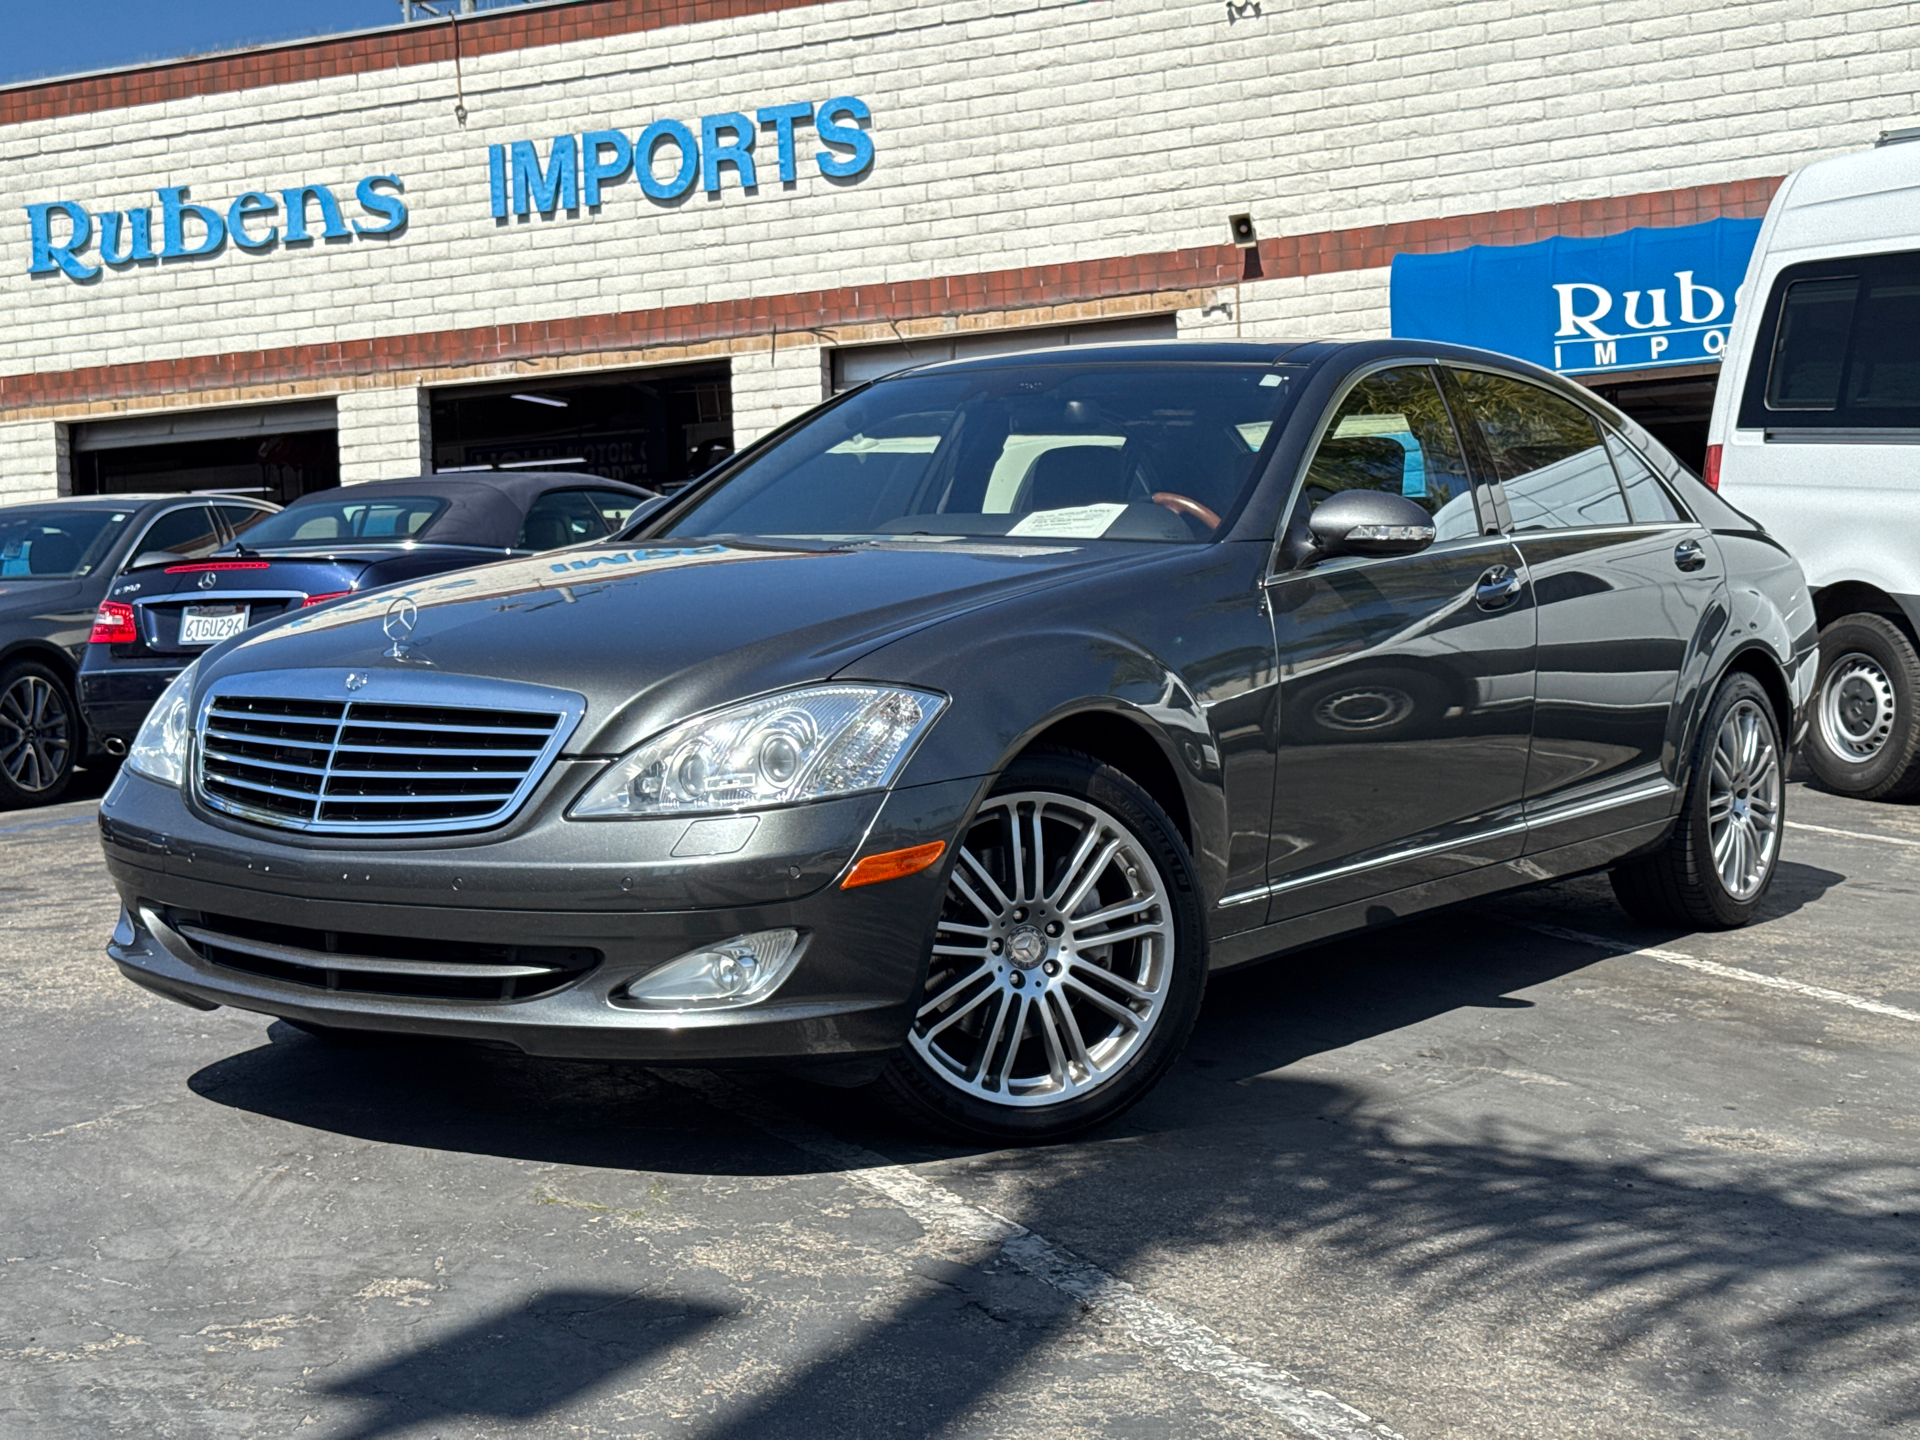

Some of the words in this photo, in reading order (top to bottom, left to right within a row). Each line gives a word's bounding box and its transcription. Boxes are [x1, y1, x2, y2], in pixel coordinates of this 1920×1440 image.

[26, 175, 405, 279] Rubens
[489, 96, 874, 218] IMPORTS
[185, 617, 242, 638] 6TGU296
